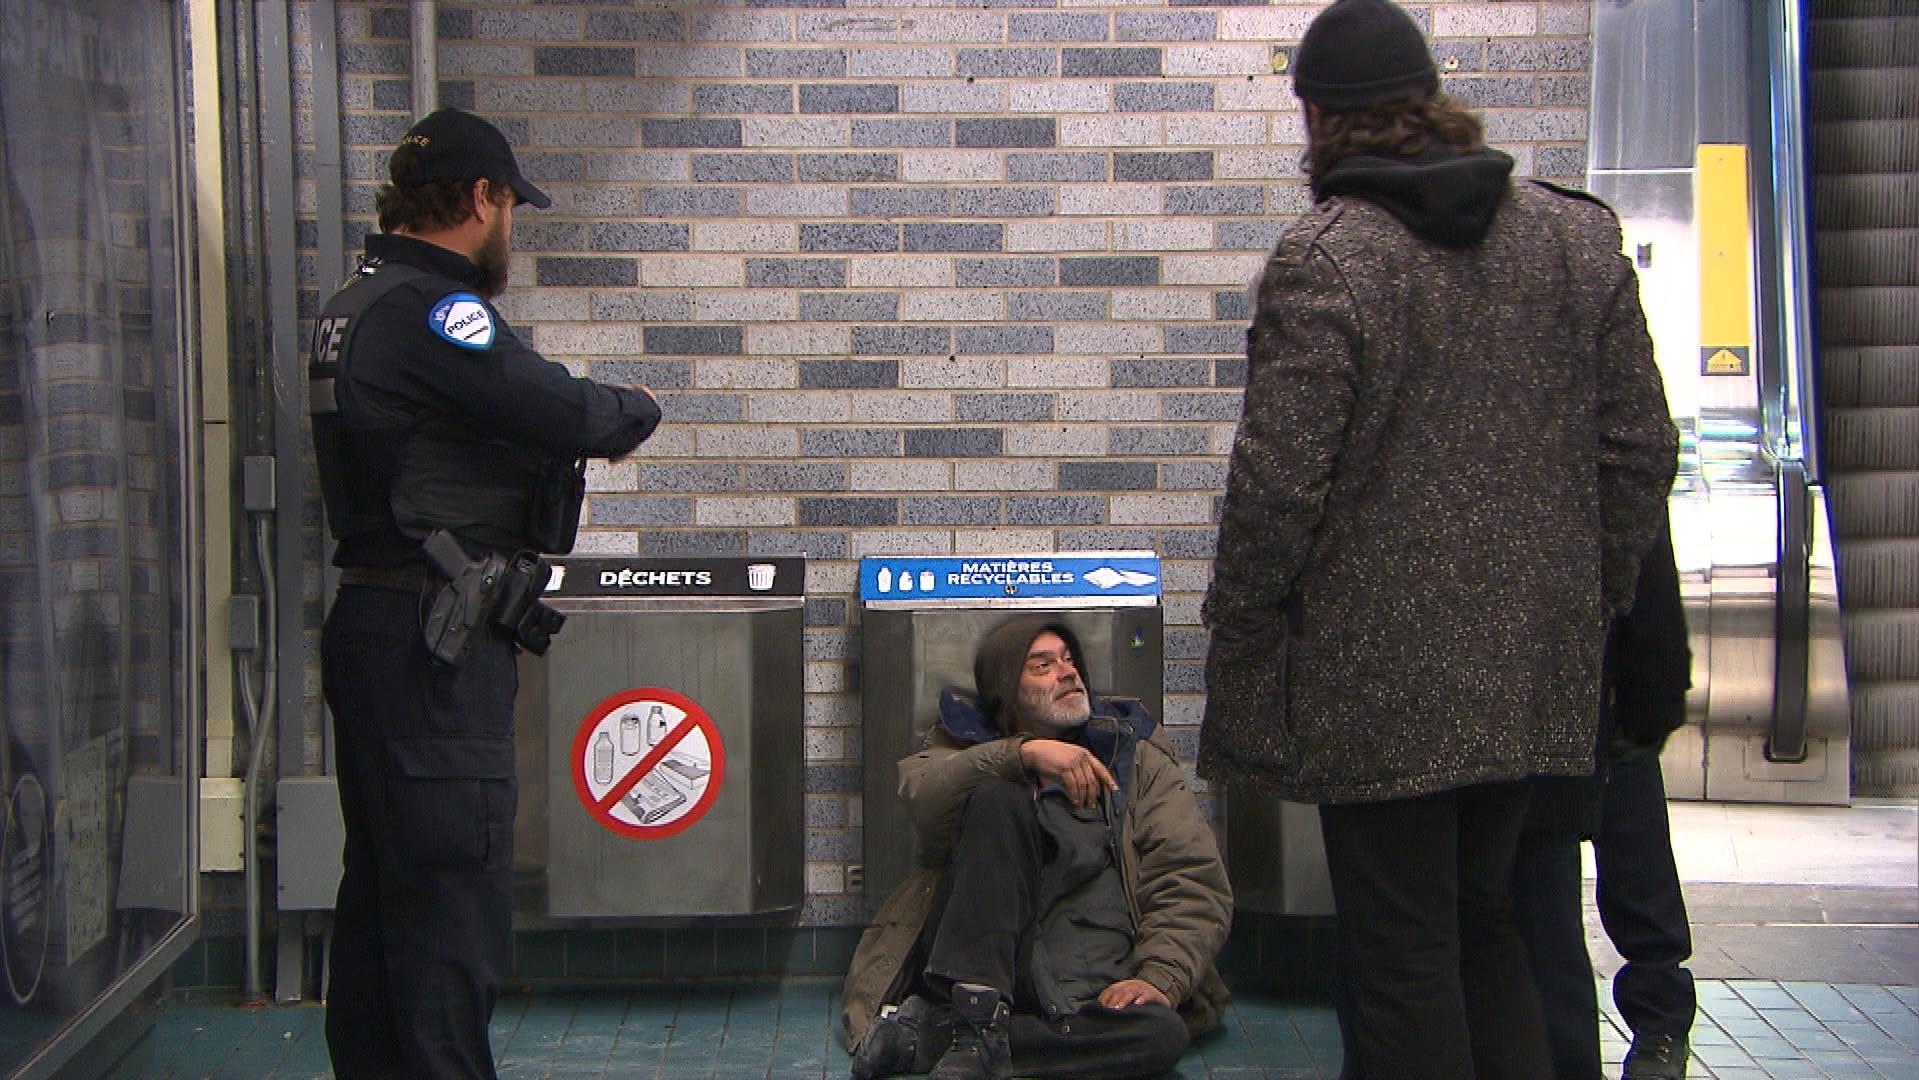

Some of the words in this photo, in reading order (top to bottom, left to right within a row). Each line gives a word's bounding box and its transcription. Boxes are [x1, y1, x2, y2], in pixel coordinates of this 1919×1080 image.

[446, 309, 485, 335] POLICE
[961, 559, 1054, 573] MATIÈRES
[599, 567, 712, 587] DÉCHETS
[946, 572, 1074, 585] RECYCLABLES
